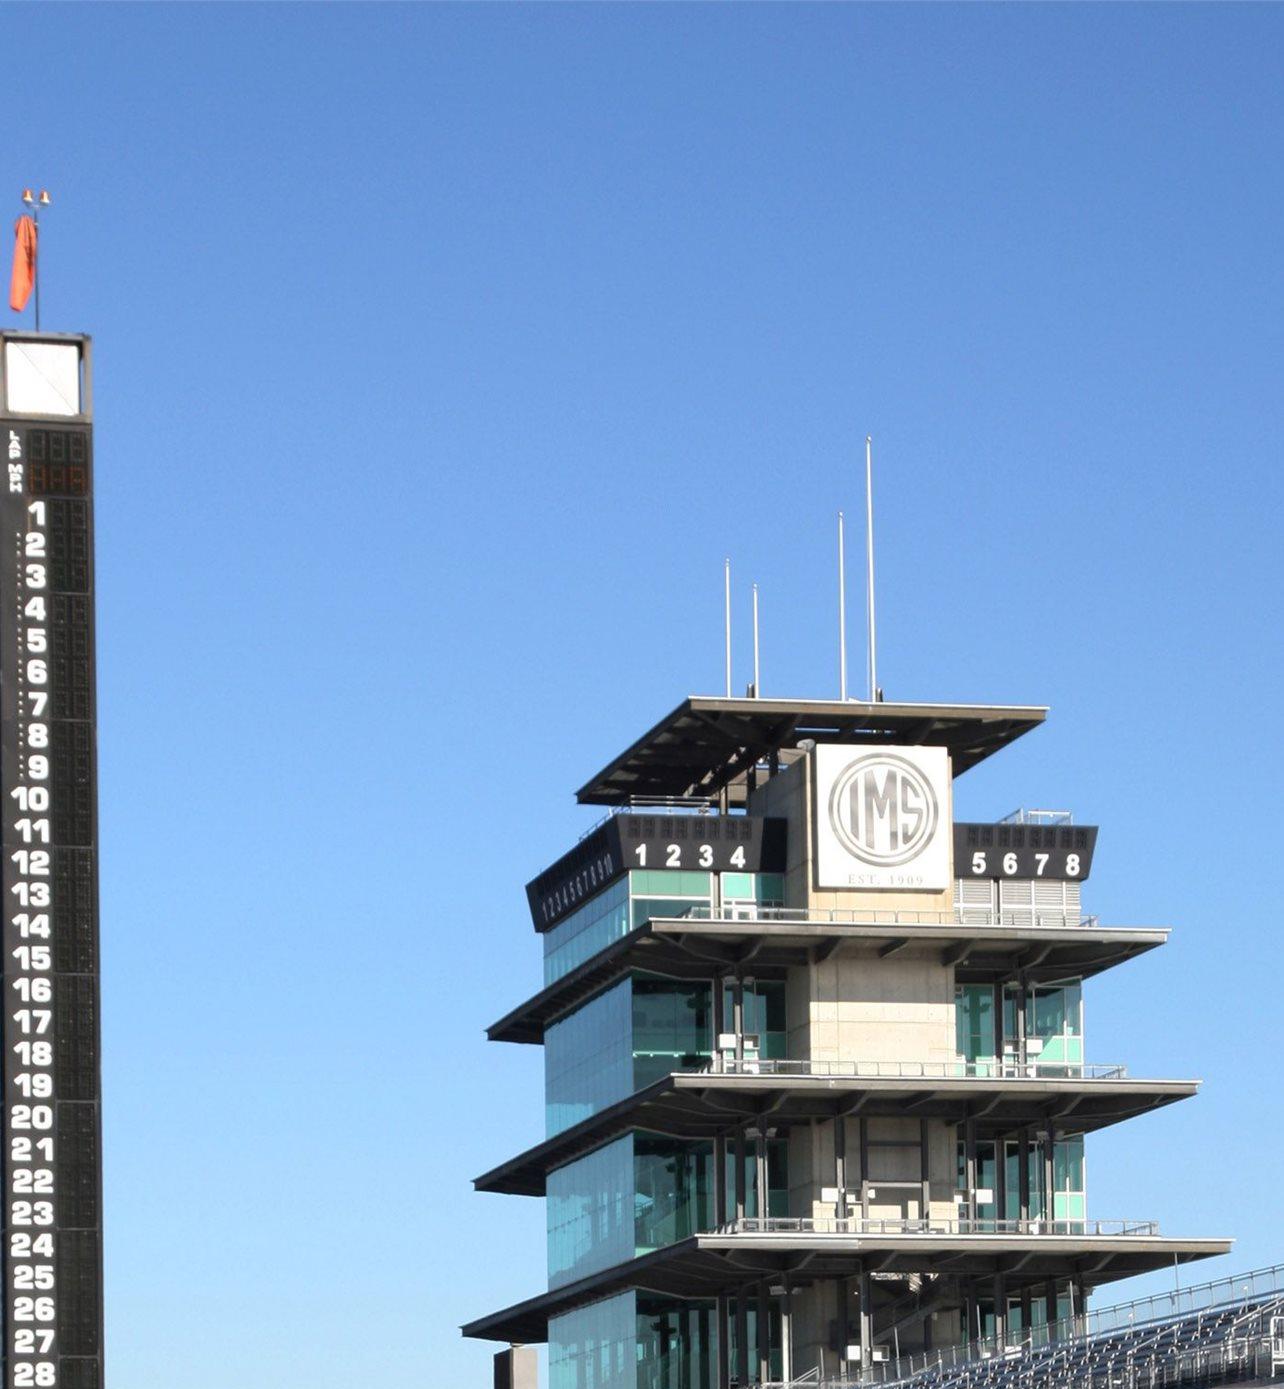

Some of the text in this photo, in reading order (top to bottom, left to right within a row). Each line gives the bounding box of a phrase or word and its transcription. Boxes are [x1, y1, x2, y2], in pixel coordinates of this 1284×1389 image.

[9, 430, 21, 459] LAP
[8, 463, 23, 493] MPH
[27, 500, 45, 526] 1
[25, 531, 45, 557] 2
[25, 563, 46, 588] 3
[24, 596, 46, 621] 4
[26, 627, 47, 653] 5
[26, 659, 47, 684] 6
[27, 691, 47, 716] 7
[27, 722, 48, 748] 8
[27, 754, 48, 779] 9
[10, 786, 49, 811] 10
[850, 769, 923, 851] IMS
[13, 818, 49, 843] 11
[10, 849, 49, 875] 12
[635, 844, 746, 869] 1 2 3 4
[971, 852, 1081, 877] 5 6 7 8
[848, 874, 924, 886] EST. 1909
[10, 881, 50, 907] 13
[11, 913, 50, 938] 14
[11, 945, 51, 970] 15
[12, 977, 51, 1002] 16
[12, 1009, 51, 1034] 17
[13, 1040, 52, 1066] 18
[13, 1072, 52, 1097] 19
[10, 1104, 52, 1129] 20
[11, 1136, 53, 1161] 21
[12, 1168, 53, 1193] 22
[11, 1200, 53, 1225] 23
[10, 1232, 54, 1257] 24
[13, 1264, 54, 1289] 25
[13, 1296, 55, 1321] 26
[14, 1328, 54, 1353] 27
[13, 1361, 55, 1387] 28
